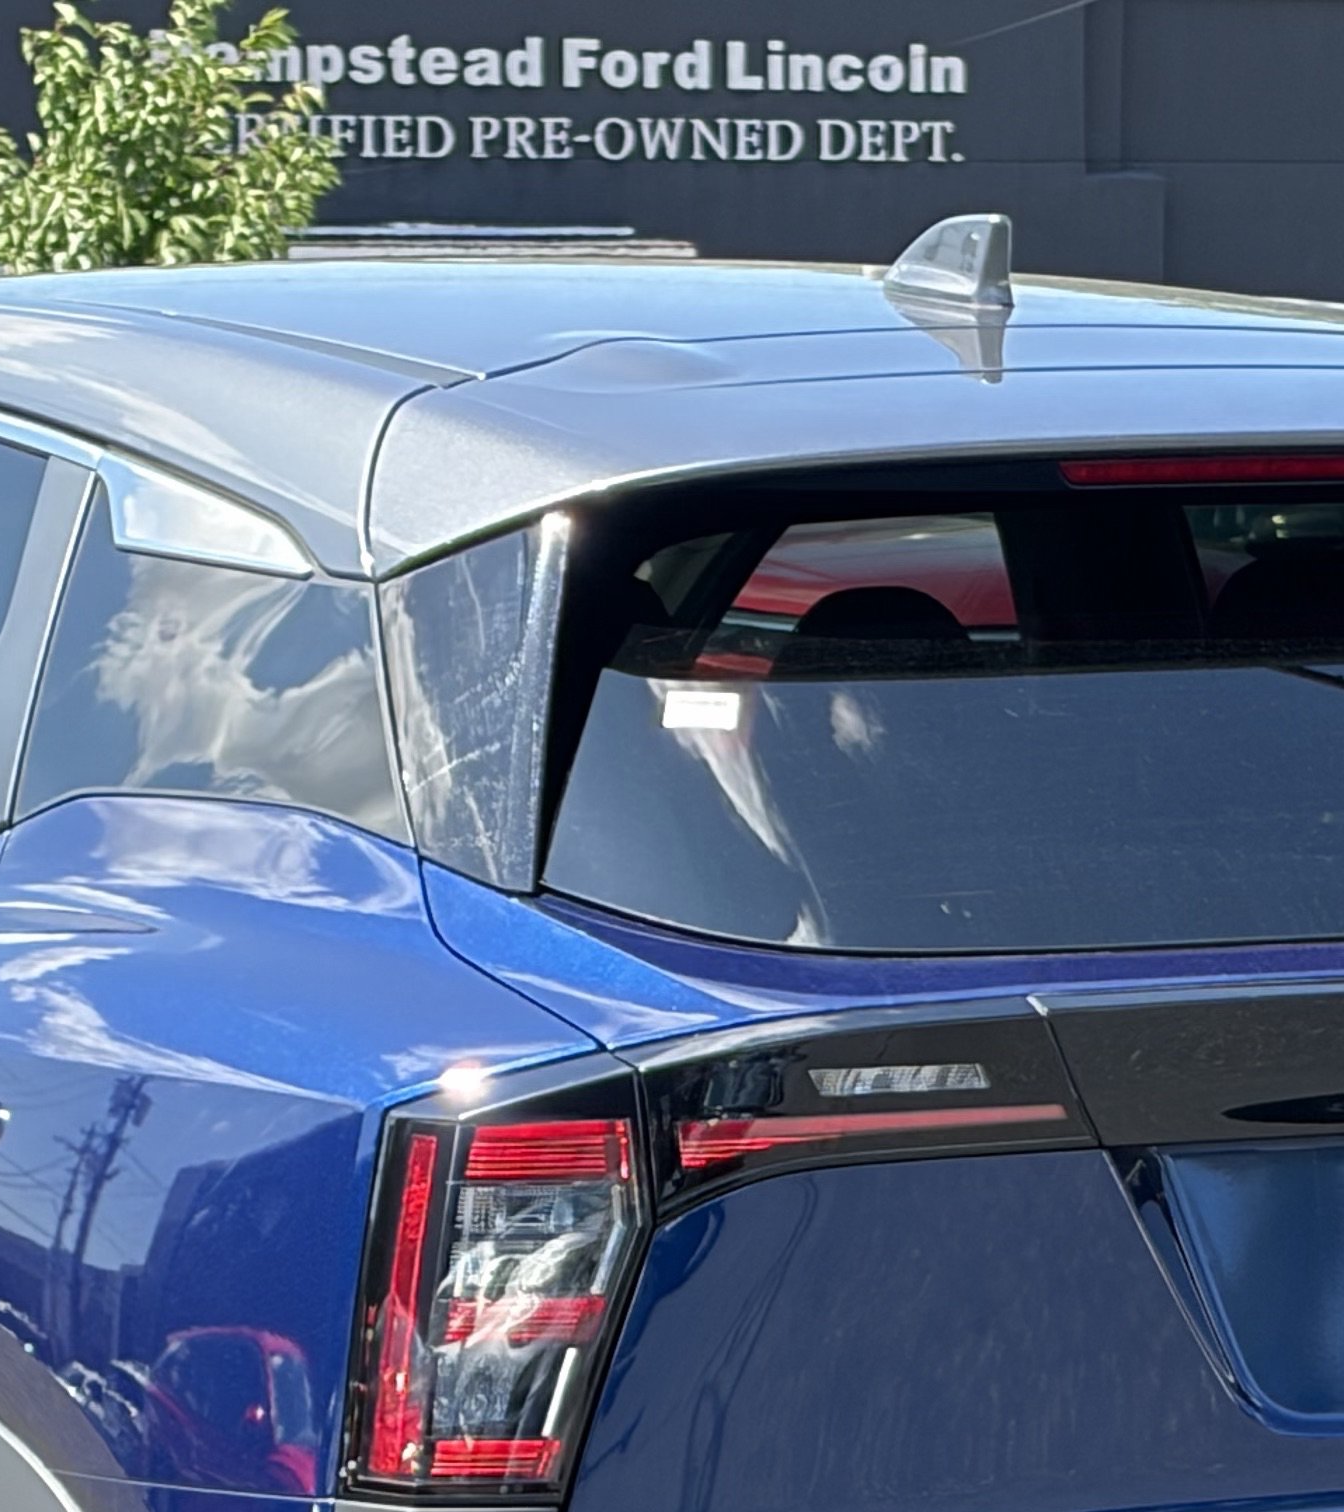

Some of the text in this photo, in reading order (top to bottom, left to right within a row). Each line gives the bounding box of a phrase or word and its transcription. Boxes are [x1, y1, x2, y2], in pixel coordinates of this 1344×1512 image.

[562, 38, 711, 91] Ford
[727, 41, 966, 94] Lincoln
[469, 115, 807, 163] PRE-OWNED
[818, 117, 965, 163] DEPT.
